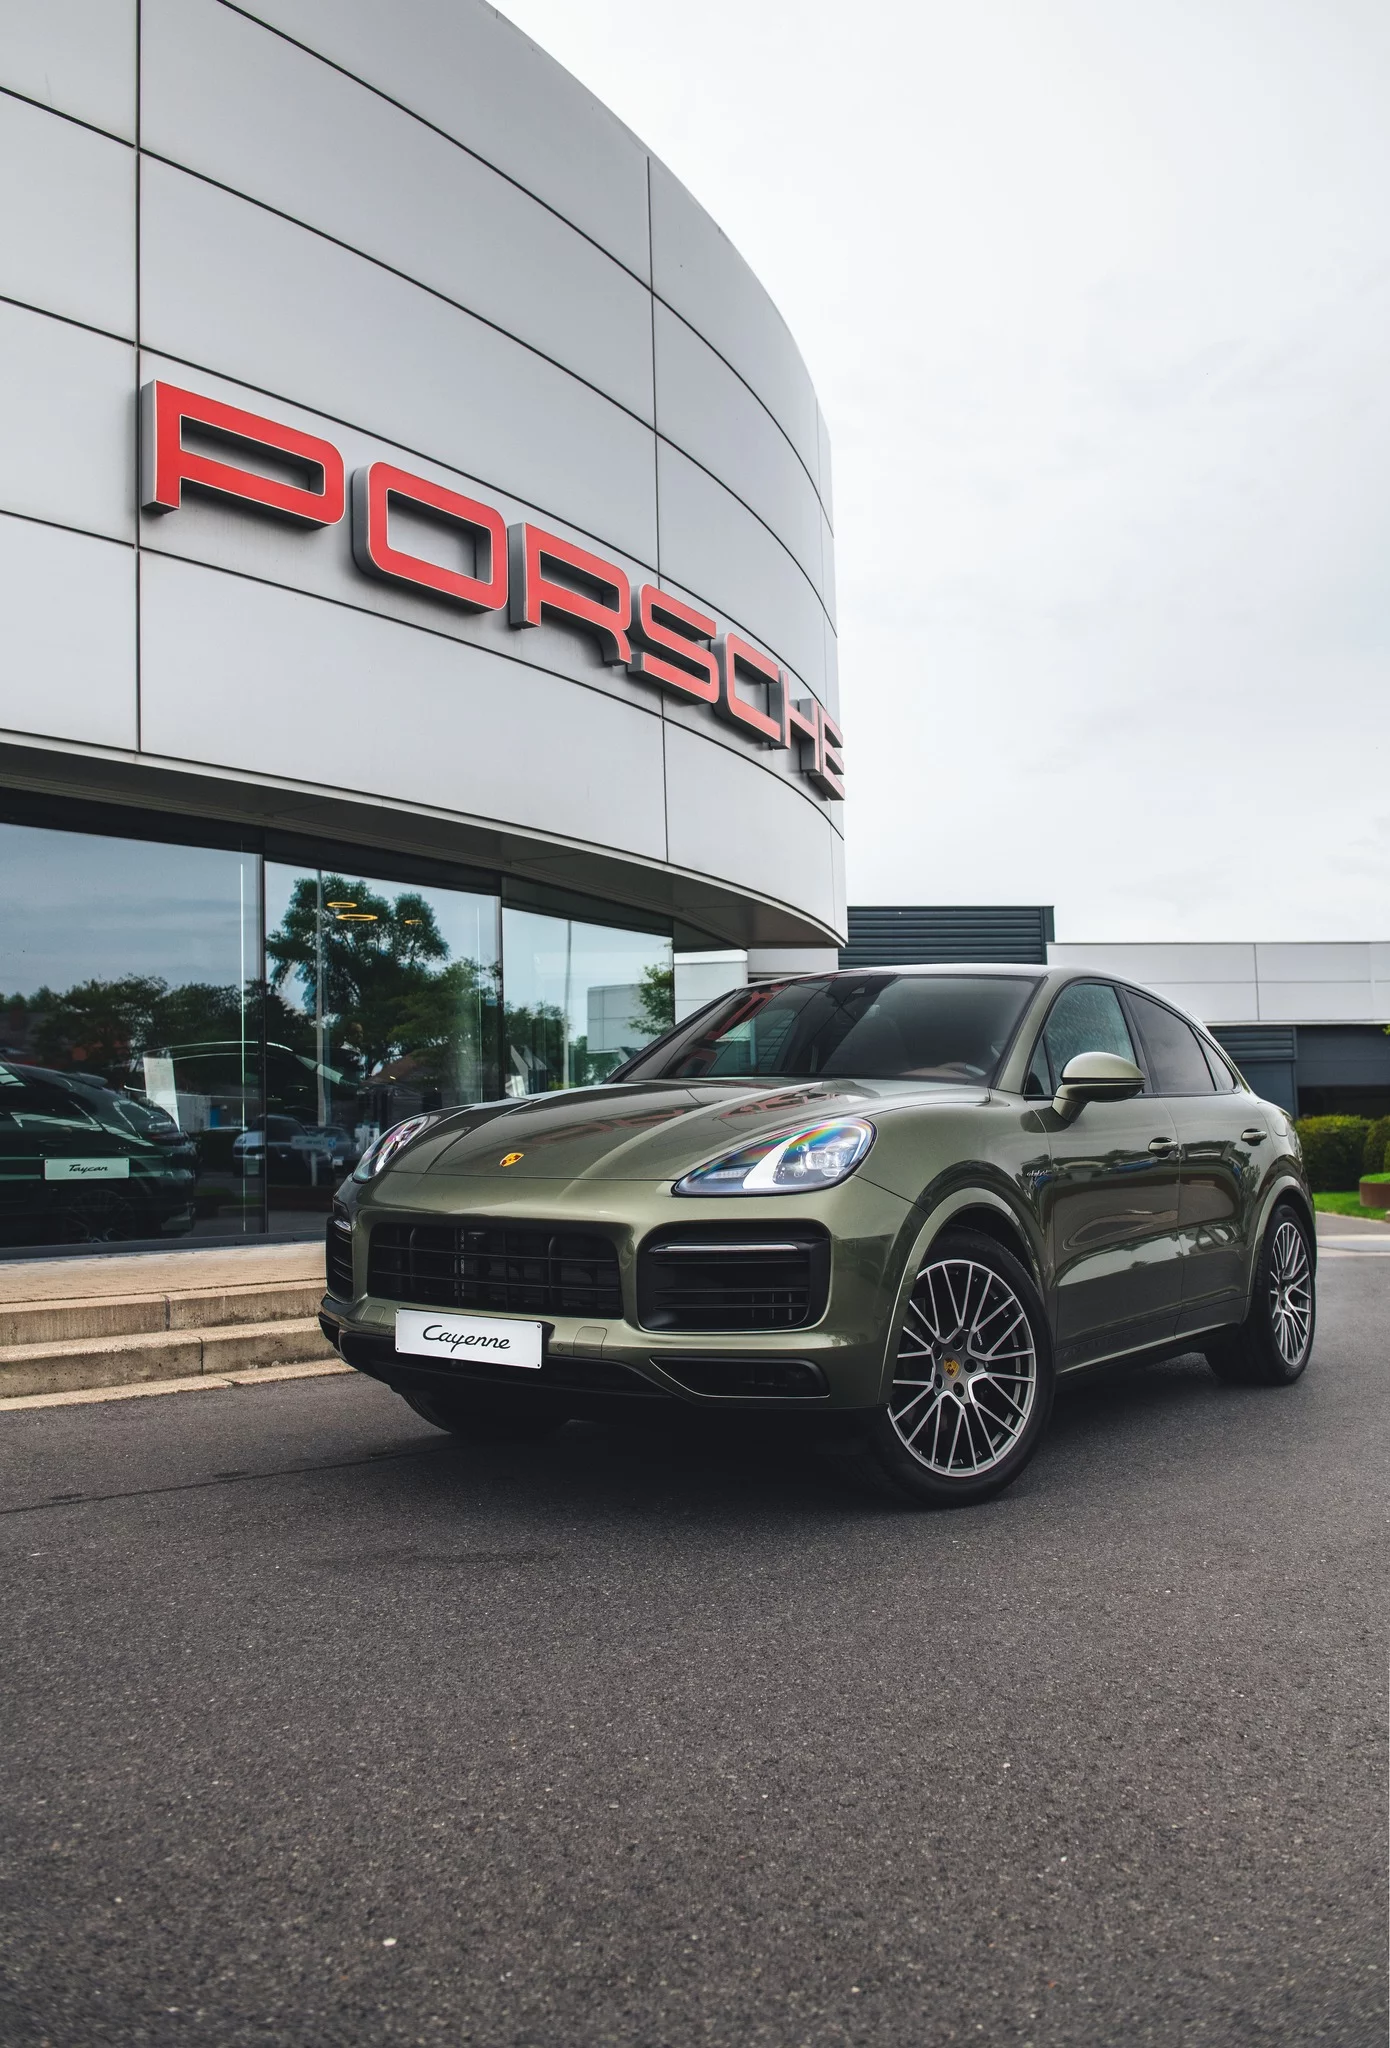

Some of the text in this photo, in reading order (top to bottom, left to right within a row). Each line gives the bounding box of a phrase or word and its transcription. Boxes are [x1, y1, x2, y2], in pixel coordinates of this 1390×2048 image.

[142, 379, 845, 800] PORSCHE
[68, 1163, 108, 1174] Taycan
[422, 1324, 511, 1353] Cayenne
